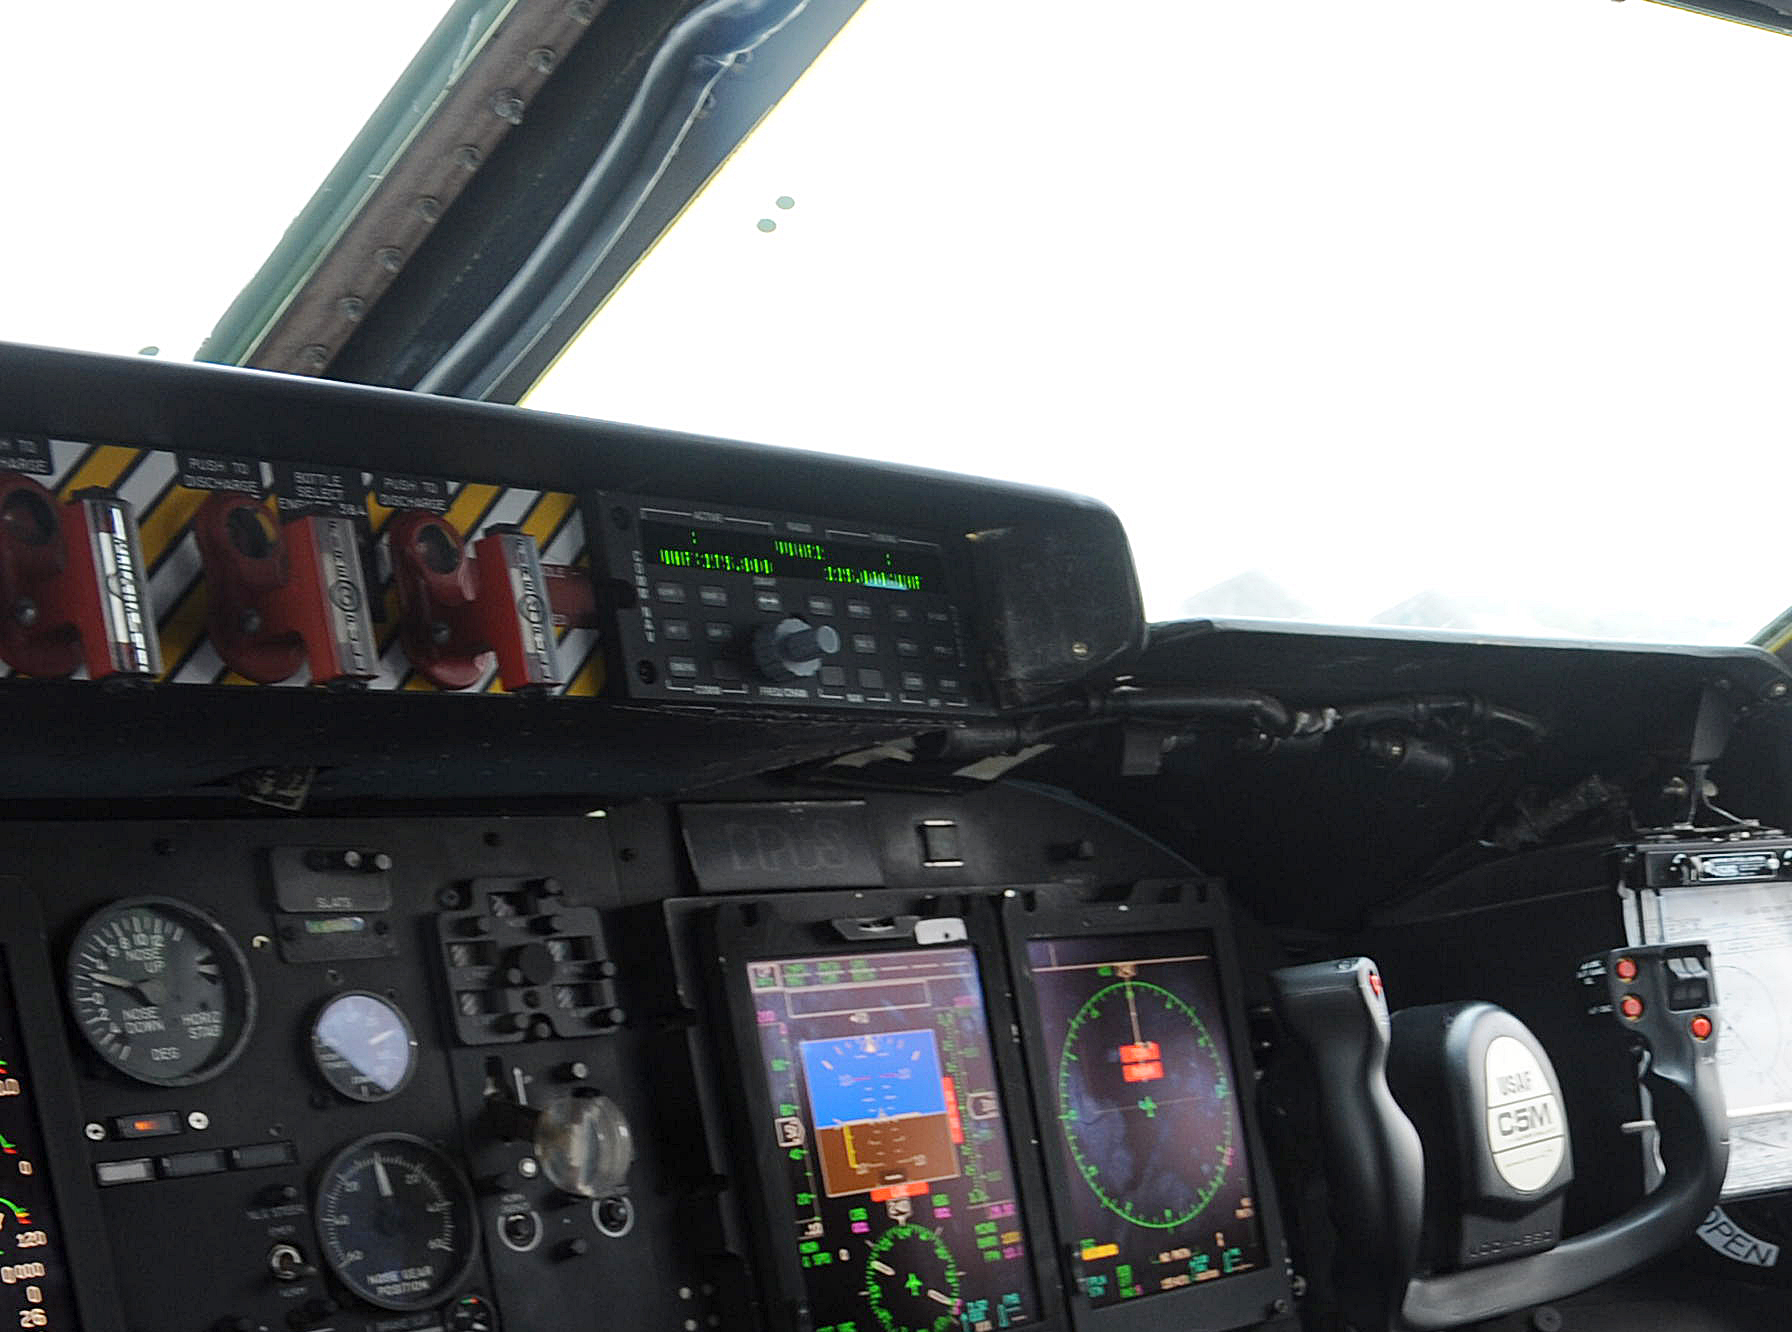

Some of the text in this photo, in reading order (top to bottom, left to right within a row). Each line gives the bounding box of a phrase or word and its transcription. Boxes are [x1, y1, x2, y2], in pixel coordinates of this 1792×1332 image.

[121, 1006, 161, 1022] NOSE
[123, 1020, 166, 1035] DOWN
[150, 1046, 182, 1062] DEG
[18, 1308, 49, 1329] 26
